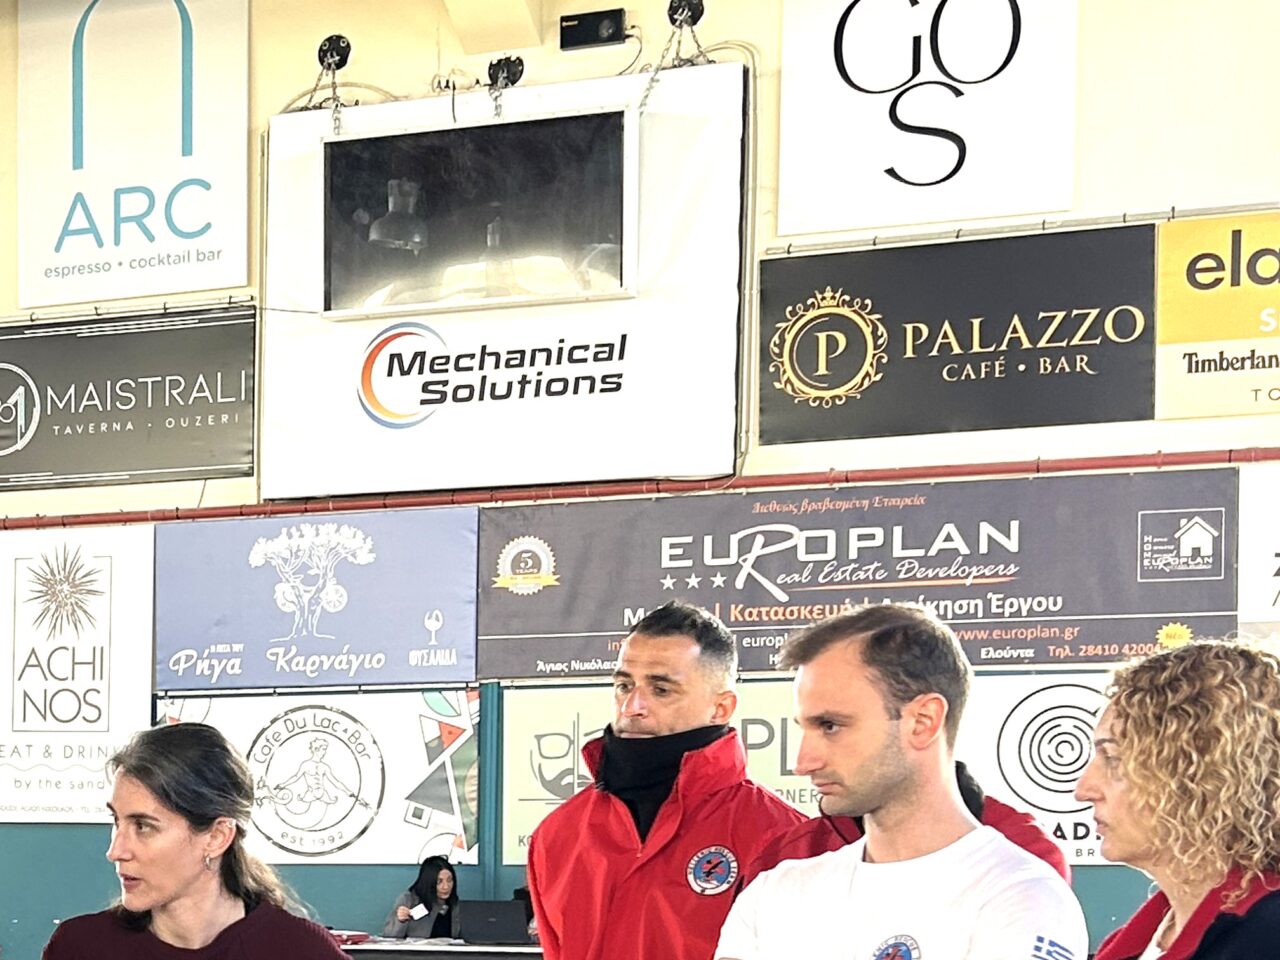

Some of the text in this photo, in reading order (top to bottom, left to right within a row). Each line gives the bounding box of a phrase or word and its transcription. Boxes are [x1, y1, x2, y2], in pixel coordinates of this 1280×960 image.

[54, 178, 212, 253] ARC
[44, 248, 223, 279] espresso cocktail bar
[902, 305, 1146, 359] PALAZZO
[387, 334, 628, 377] Mechanical
[942, 354, 1098, 382] CAFÉ BAR
[46, 370, 247, 416] MAISTRALI
[420, 371, 624, 406] Solutions
[53, 414, 239, 436] TAVERNA OUZERI
[520, 552, 533, 569] 5
[817, 559, 888, 583] Estate
[894, 555, 1021, 586] Developers
[986, 592, 1063, 622] Έργου
[17, 646, 104, 682] ACHI
[169, 645, 386, 684] Ρήγα Καρνάγιο
[536, 659, 569, 673] Άγιος
[981, 646, 1035, 659] Ελούντα
[1047, 645, 1073, 659] Τηλ.
[1079, 644, 1119, 657] 28410
[22, 688, 102, 724] NOS
[43, 744, 53, 759] &
[283, 716, 307, 733] Du
[313, 713, 342, 733] Lac
[349, 730, 372, 760] Bar
[14, 778, 105, 790] by the sand
[281, 832, 305, 845] est
